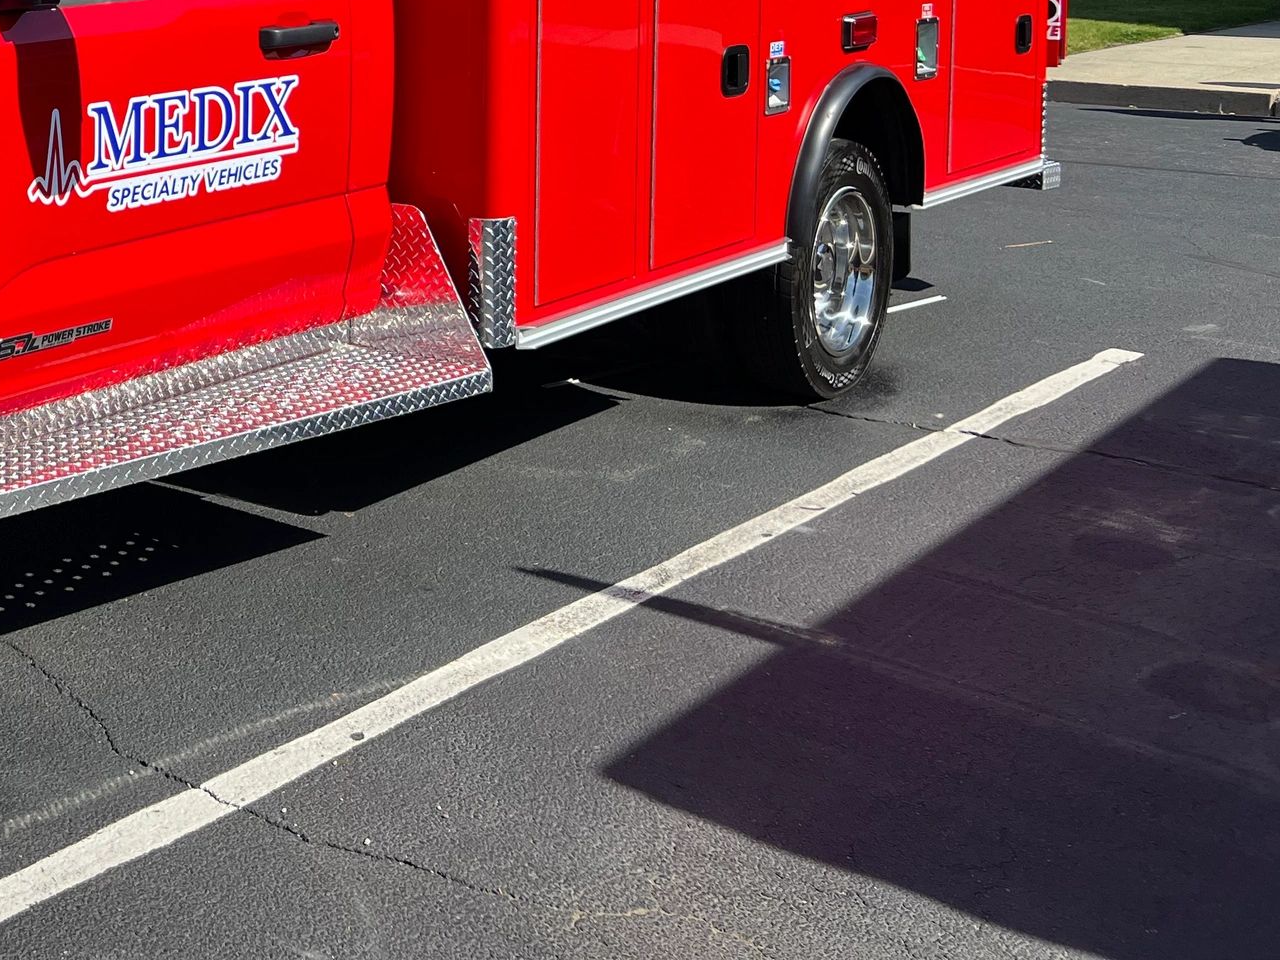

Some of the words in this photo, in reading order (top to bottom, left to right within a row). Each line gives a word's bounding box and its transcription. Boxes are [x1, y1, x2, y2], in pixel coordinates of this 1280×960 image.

[90, 78, 297, 171] MEDIX
[110, 173, 201, 208] SPECIALTY
[206, 158, 280, 187] VEHICLES
[41, 329, 75, 345] POWER
[75, 319, 112, 337] STROKE
